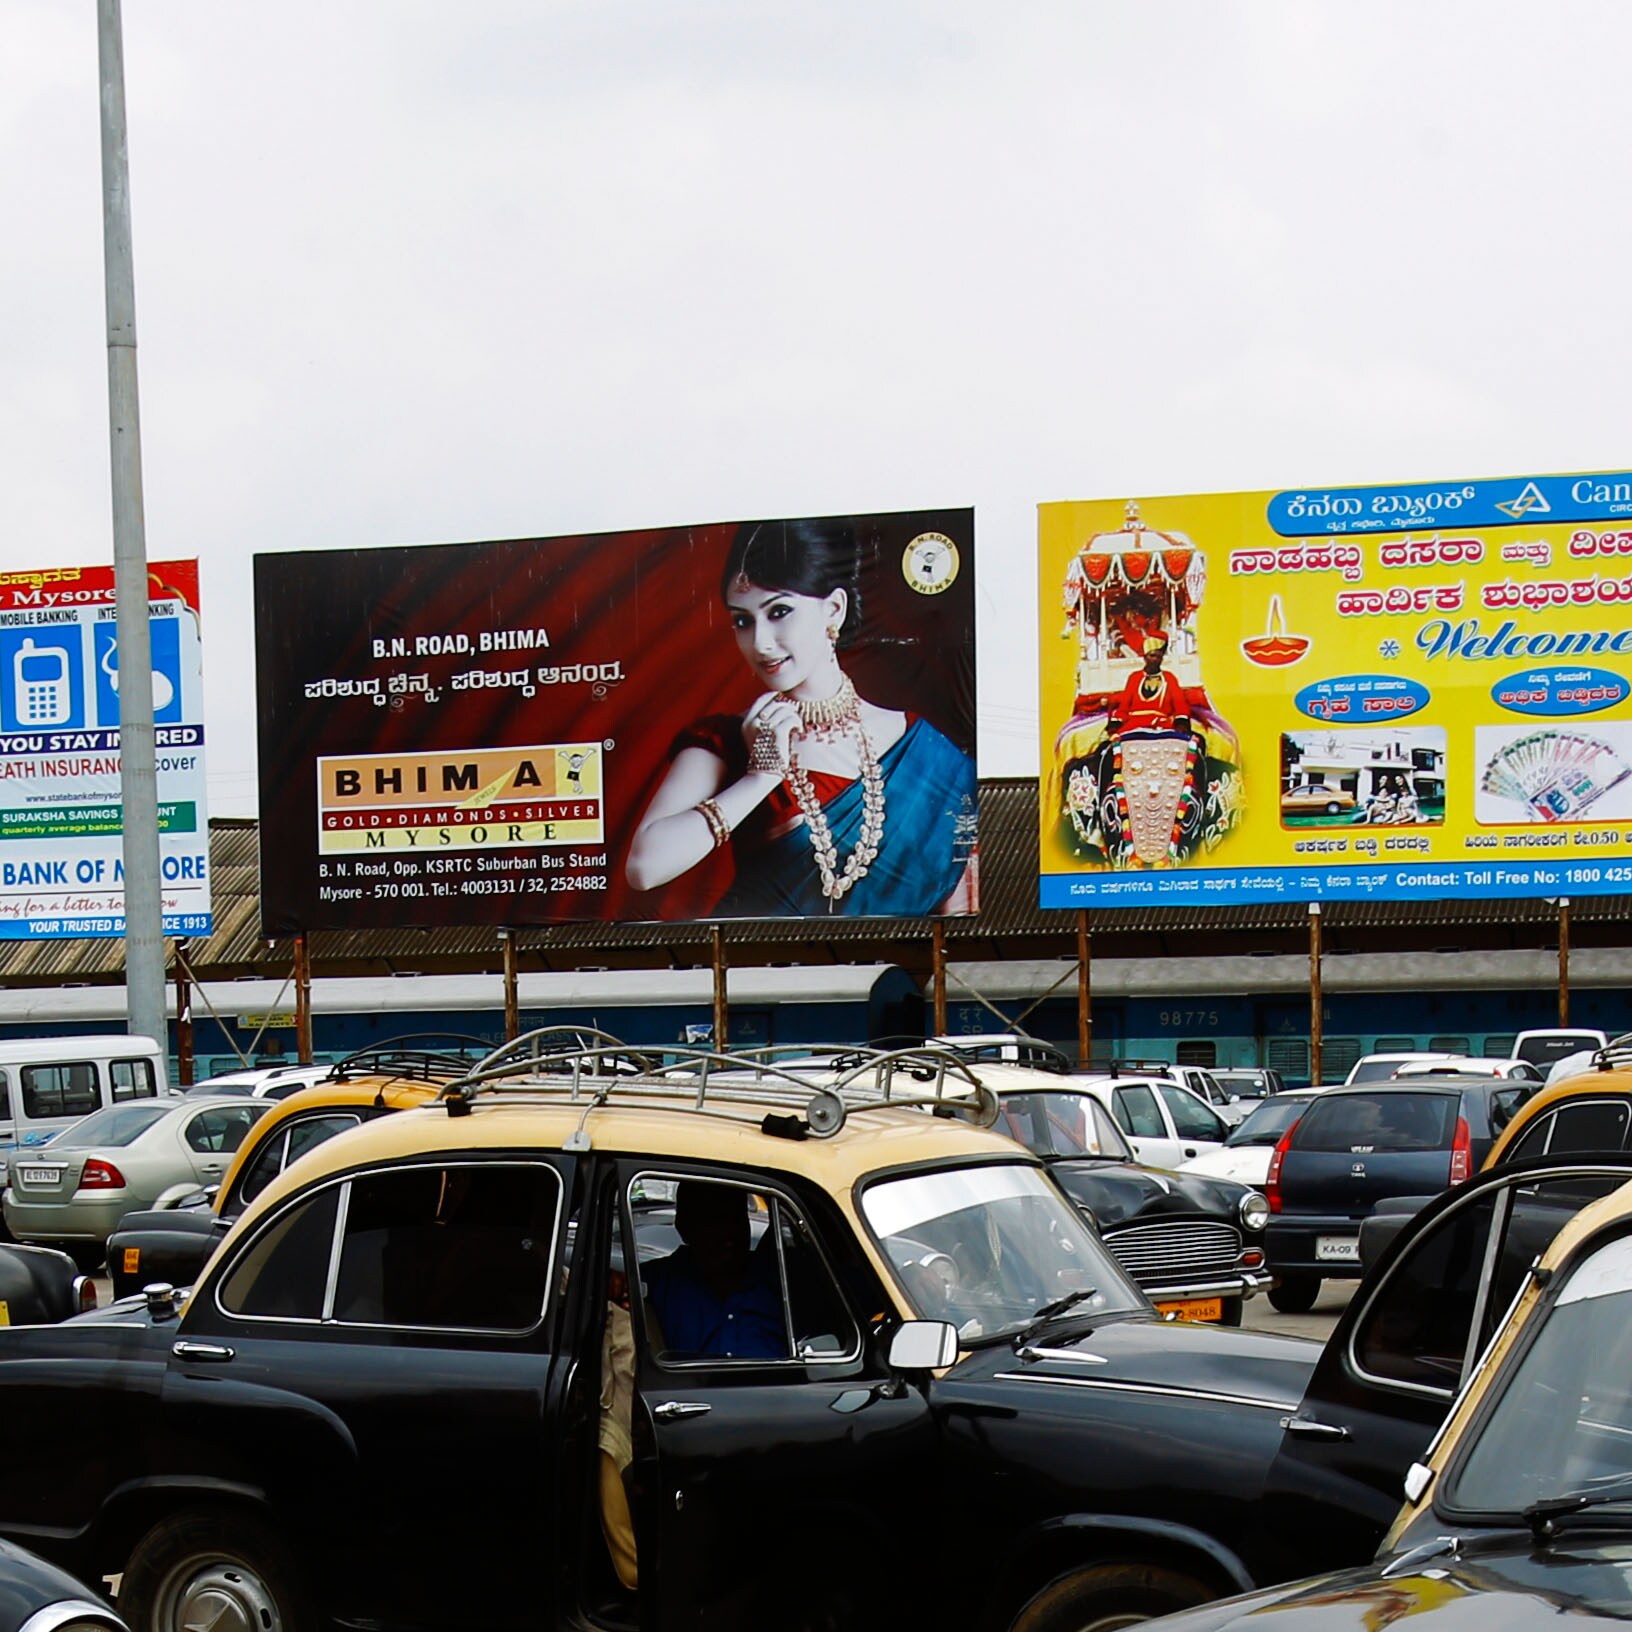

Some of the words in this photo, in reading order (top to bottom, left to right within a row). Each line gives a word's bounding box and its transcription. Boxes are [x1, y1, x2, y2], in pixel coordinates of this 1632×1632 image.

[1287, 495, 1362, 518] ಕೆನರಾ
[1372, 486, 1475, 516] ಬ್ಯಾಂಕ್
[1230, 542, 1362, 581] ನಾಡಹಬ್ಬ
[1381, 537, 1484, 565] ದಸರಾ
[11, 587, 116, 609] Mysore
[1338, 583, 1463, 614] ಹಾರ್ದಿಕ
[0, 611, 35, 627] MOBILE
[36, 609, 78, 625] BANKING
[373, 638, 412, 658] B.N.
[415, 634, 475, 656] ROAD,
[480, 629, 549, 651] BHIMA
[305, 678, 386, 706] ಪರಿಶುದ್ಧ
[451, 668, 536, 698] ಪರಿಶುದ್ಧ
[50, 733, 101, 751] STAY
[2, 812, 66, 823] SURAKSHA
[68, 809, 118, 821] SAVINGS
[2, 825, 46, 836] quarterly
[48, 824, 87, 834] average
[365, 824, 557, 848] MYSORE
[4, 860, 68, 887] BANK
[76, 859, 106, 883] OF
[355, 861, 390, 877] Road,
[394, 861, 422, 876] Opp.
[426, 858, 473, 874] KSRTC
[477, 855, 537, 871] Suburban
[542, 855, 566, 869] Bus
[569, 853, 607, 867] Stand
[1396, 870, 1460, 886] Contact:
[1465, 868, 1492, 883] Toll
[1496, 867, 1528, 883] Free
[1534, 867, 1560, 882] No:
[1566, 866, 1601, 881] 1800
[1605, 866, 1632, 881] 425
[319, 886, 363, 902] Mysore
[374, 884, 399, 898] 570
[401, 882, 430, 897] 001.
[460, 879, 517, 895] 4003131
[551, 876, 607, 891] 2524882
[23, 896, 45, 917] for
[62, 896, 105, 912] better
[29, 921, 59, 934] YOUR
[62, 919, 113, 933] TRUSTED
[183, 916, 208, 930] 1913
[1159, 1010, 1218, 1026] 98775
